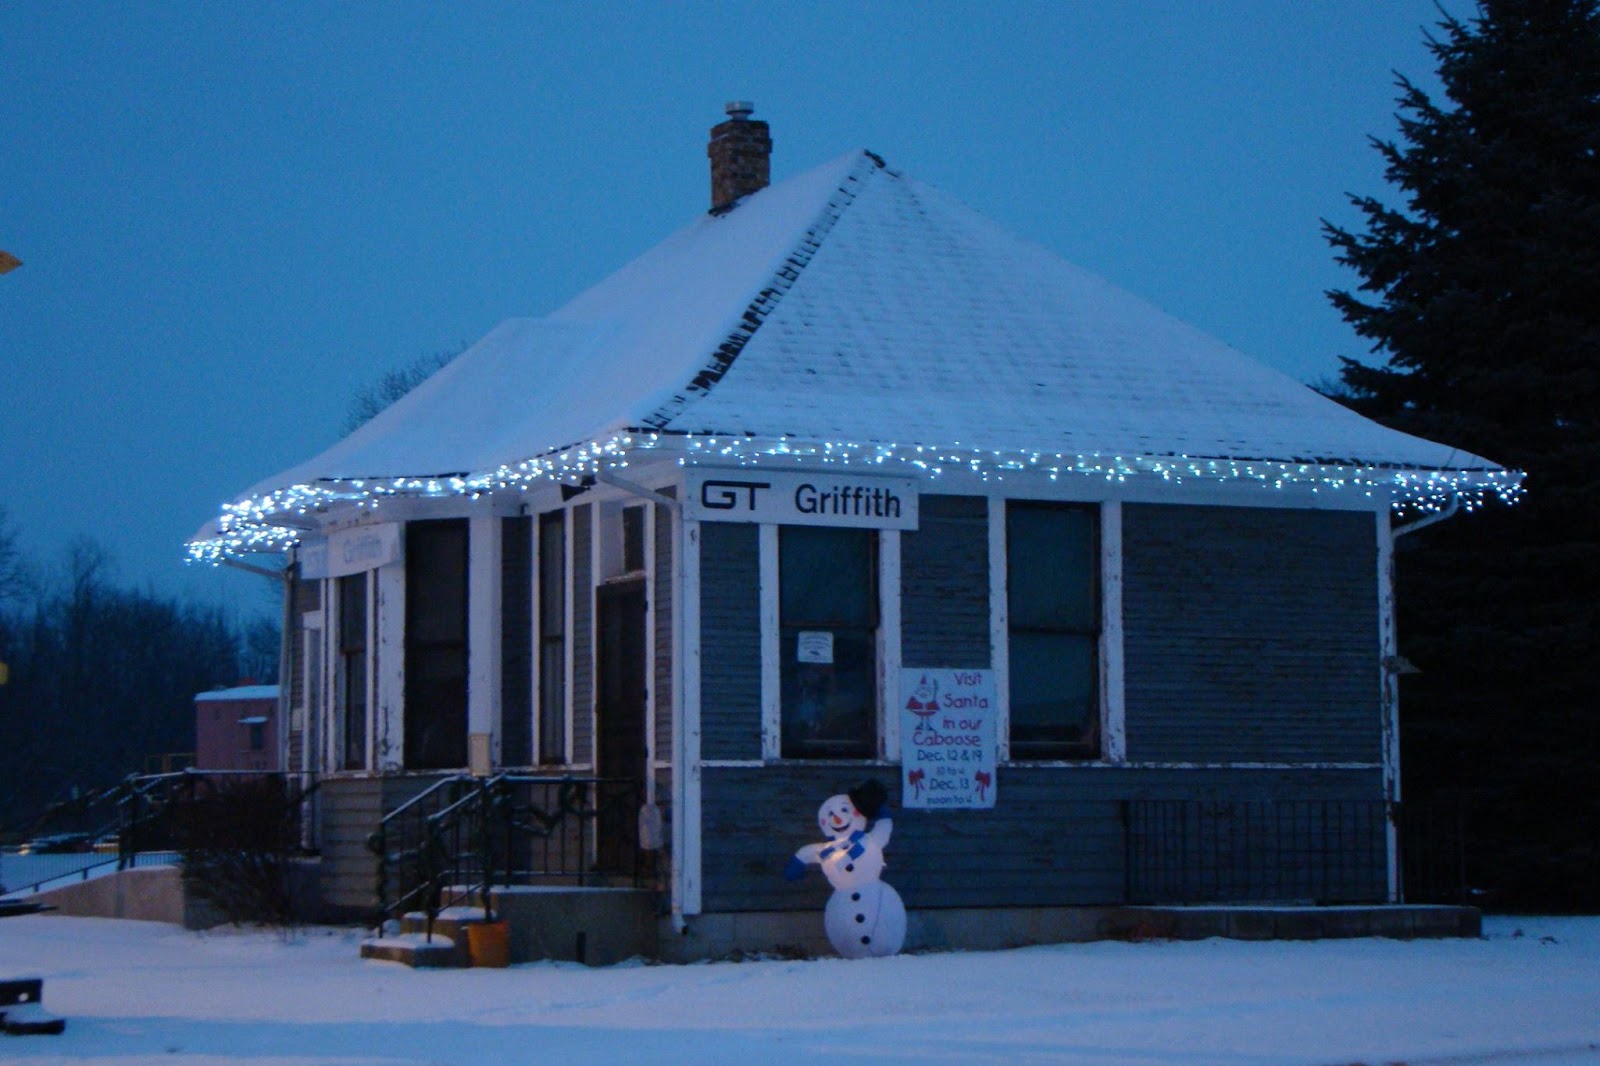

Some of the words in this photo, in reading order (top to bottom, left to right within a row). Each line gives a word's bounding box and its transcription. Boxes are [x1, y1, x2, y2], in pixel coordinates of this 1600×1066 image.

[701, 480, 771, 511] GT
[795, 483, 900, 518] Griffith
[954, 672, 982, 685] Visit
[944, 694, 988, 708] Santa
[943, 716, 955, 729] in
[960, 719, 982, 730] our
[912, 731, 981, 747] Caboose
[947, 750, 957, 760] 12
[961, 750, 969, 761] &
[972, 750, 982, 761] 19
[947, 767, 957, 775] to
[960, 779, 969, 789] 13
[954, 796, 964, 804] to
